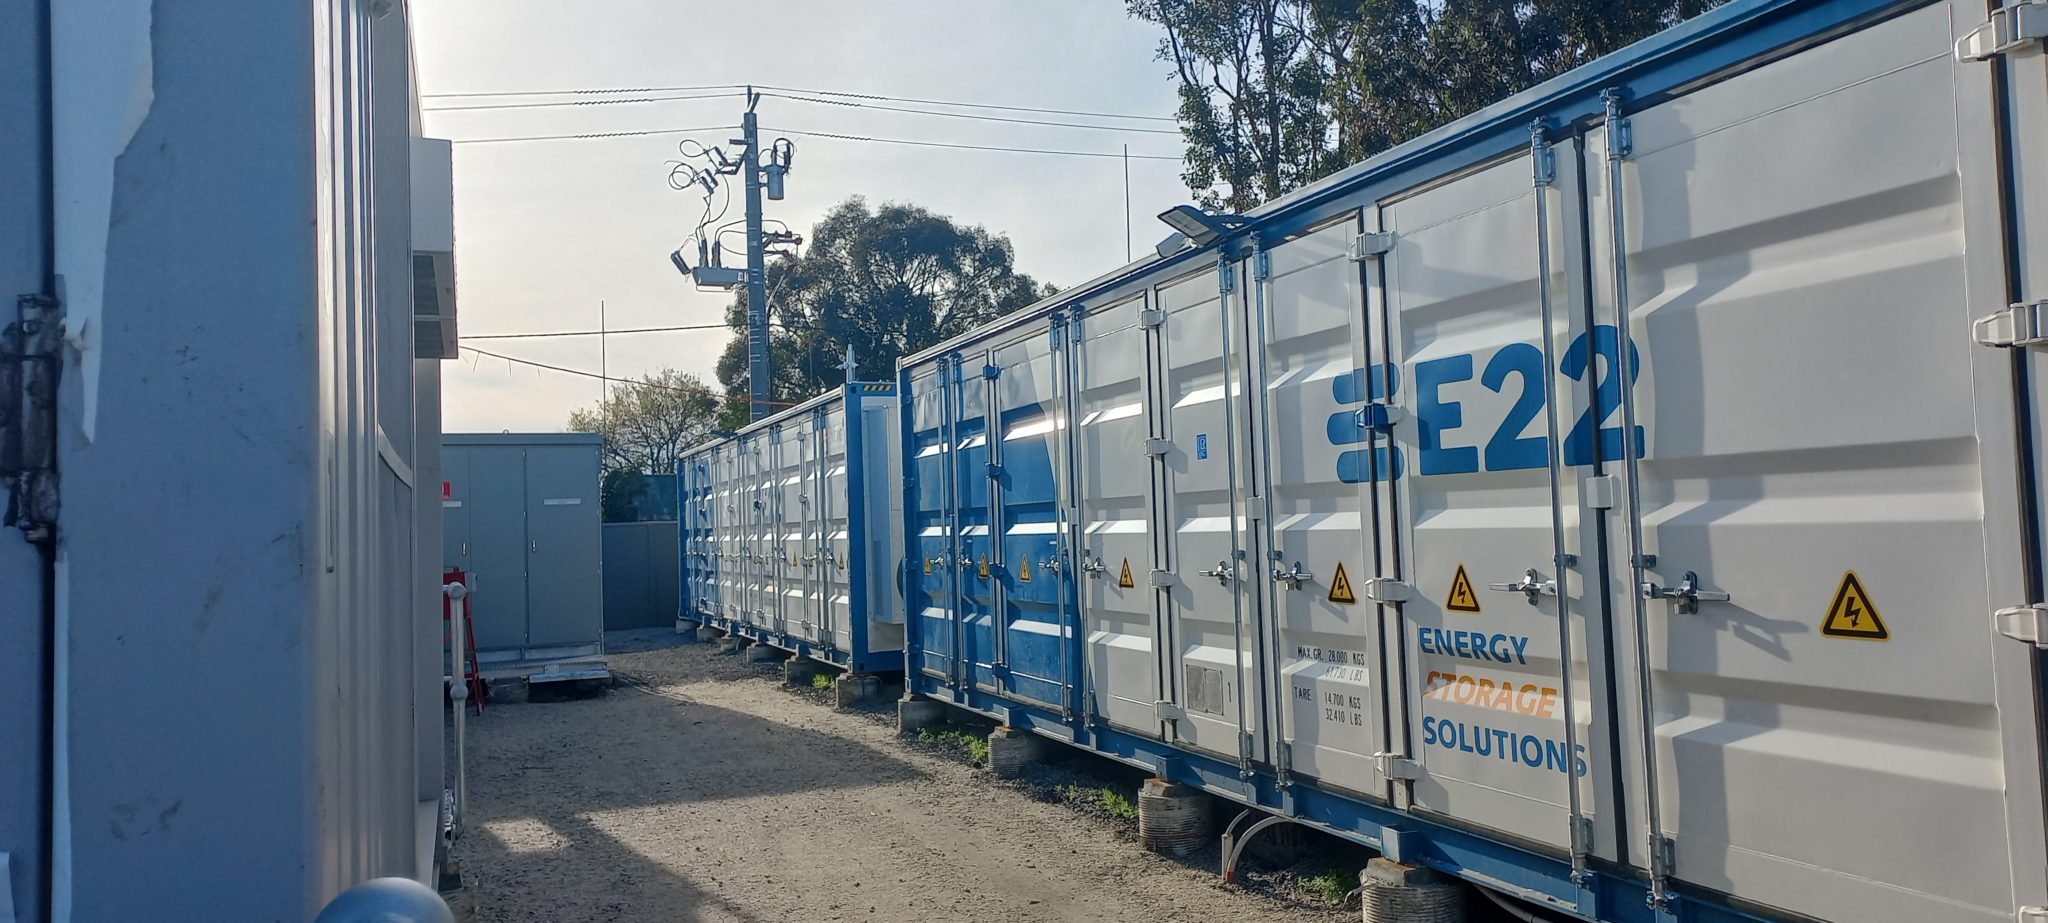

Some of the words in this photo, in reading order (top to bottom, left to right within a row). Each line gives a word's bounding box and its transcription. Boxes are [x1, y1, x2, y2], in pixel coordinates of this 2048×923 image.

[1419, 627, 1528, 665] ENERGY
[1352, 652, 1365, 666] KGS
[1349, 669, 1363, 682] LBS
[1294, 686, 1312, 701] TARE
[1324, 692, 1344, 707] 14.700
[1348, 695, 1361, 710] KGS
[1424, 671, 1557, 718] STORAGE
[1325, 708, 1345, 723] 32.410
[1349, 712, 1362, 727] LBS
[1423, 716, 1588, 778] SOLUTIONS
